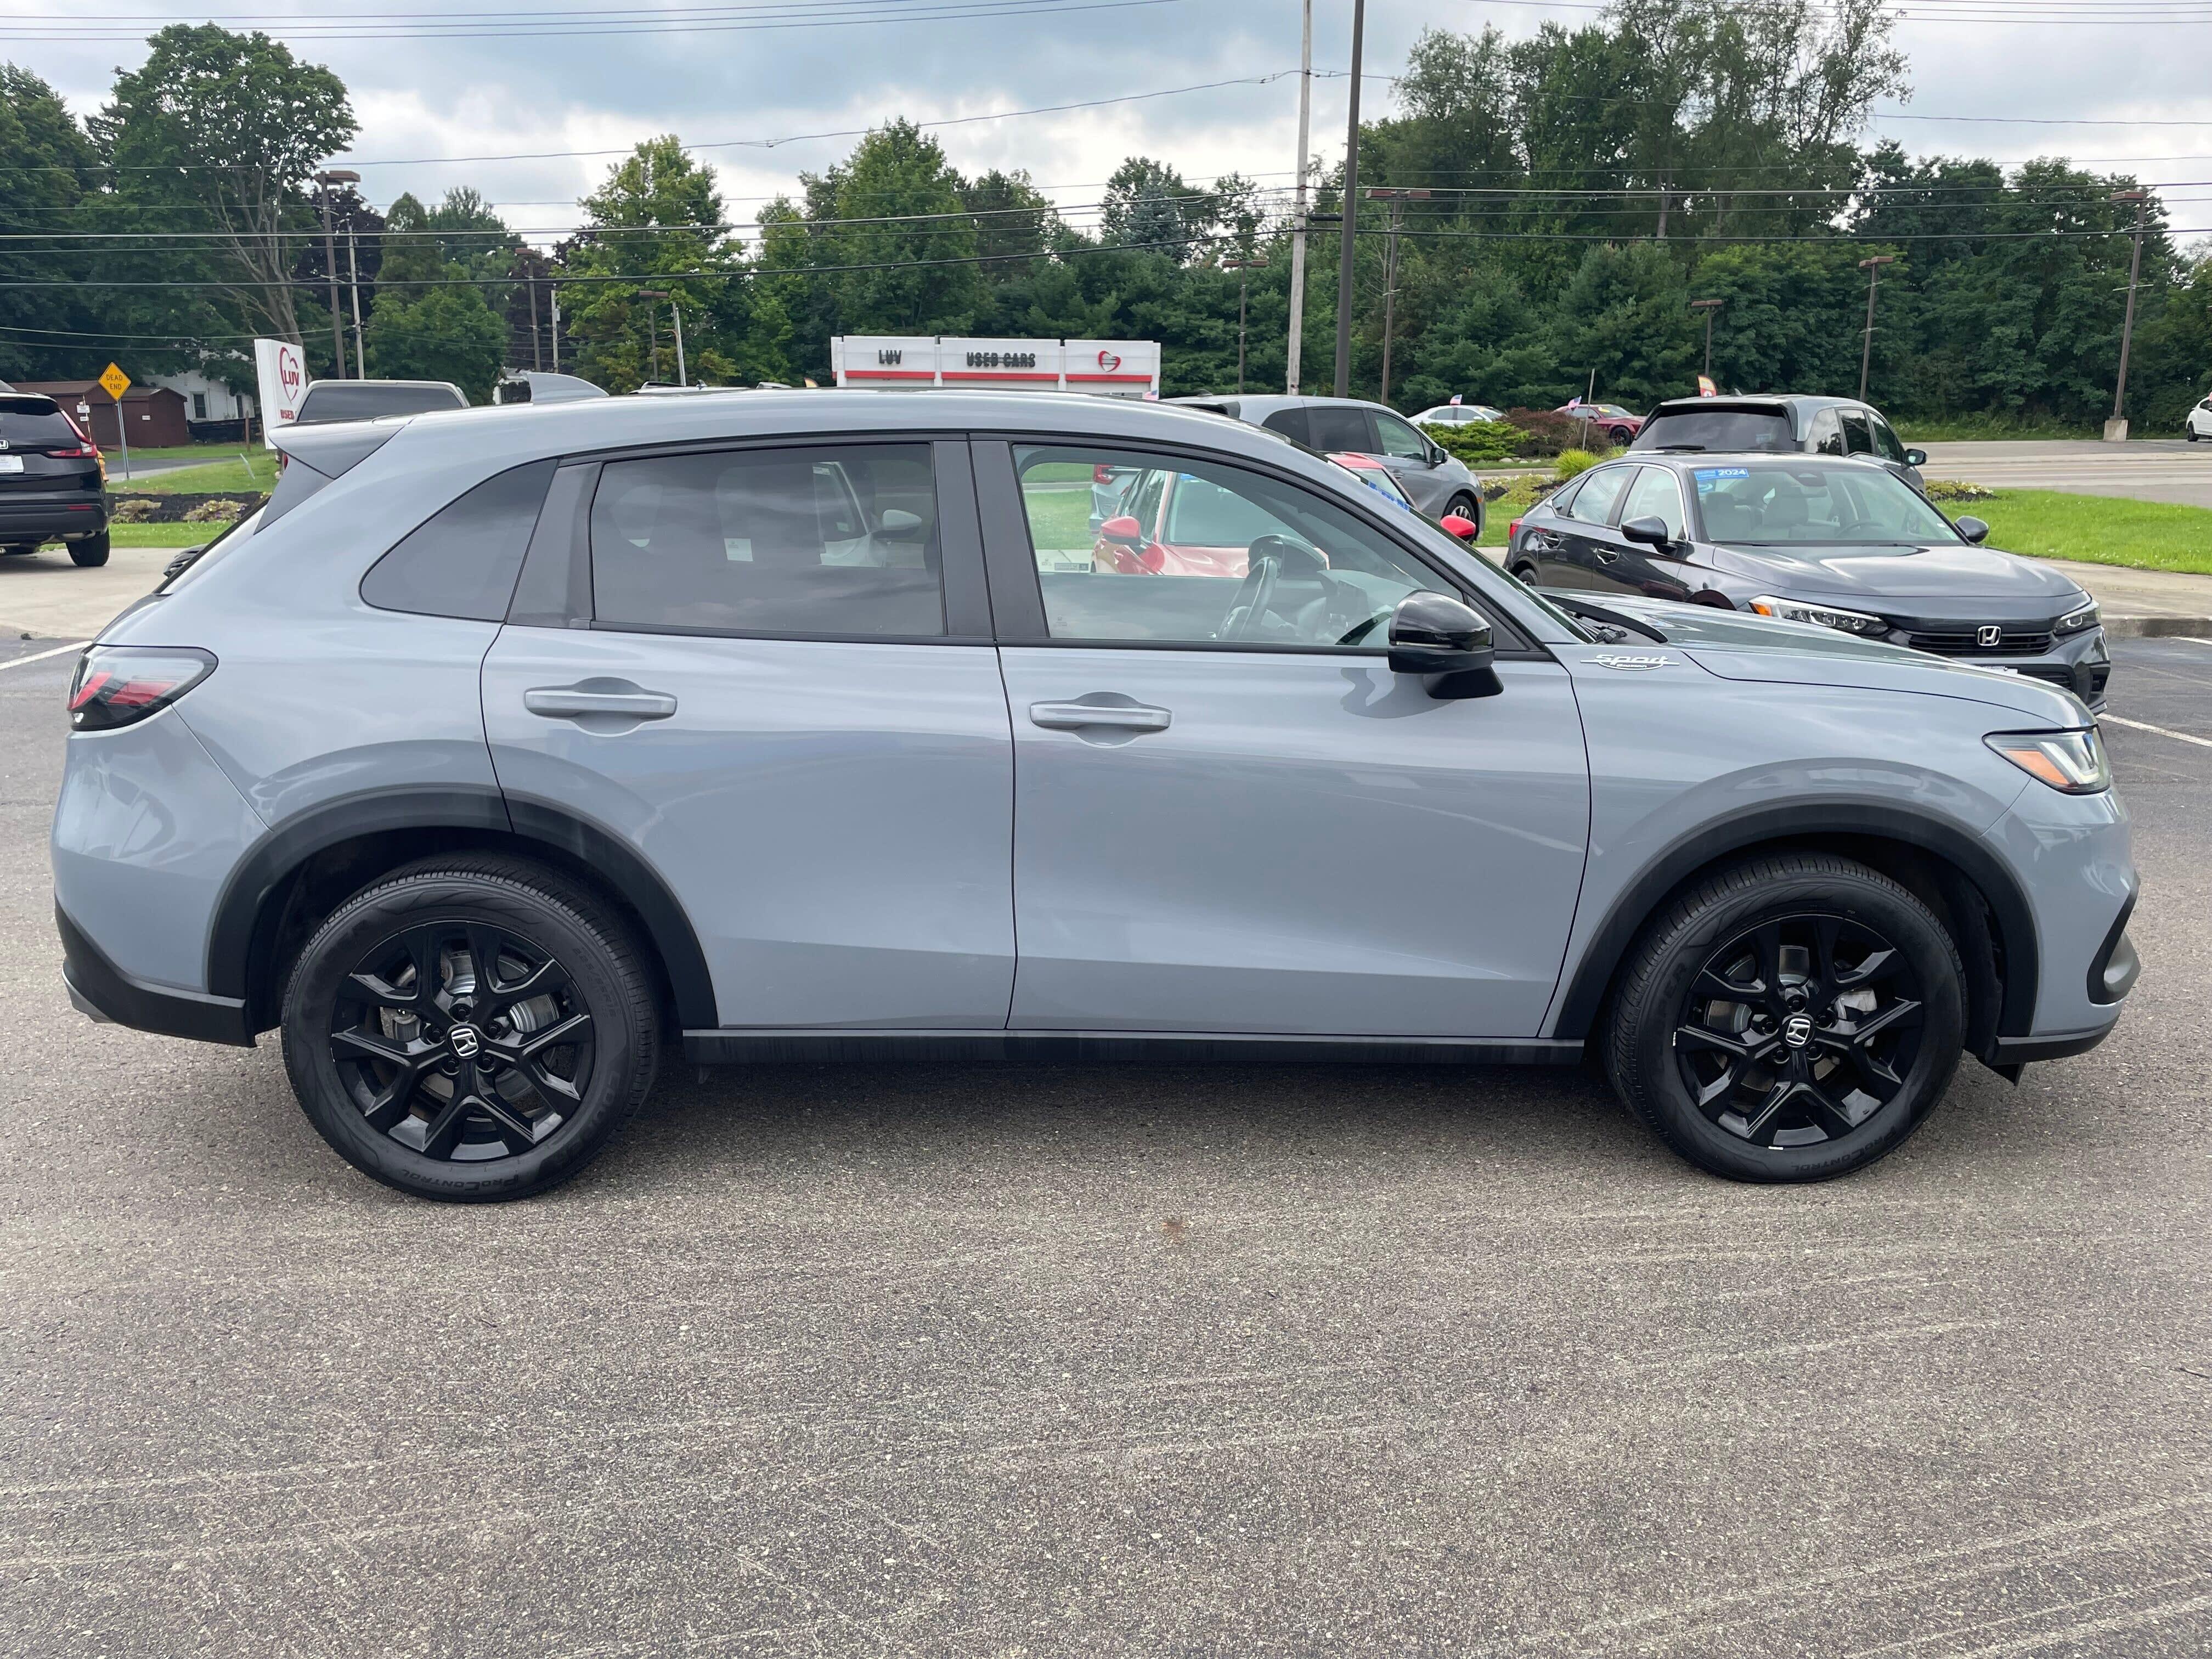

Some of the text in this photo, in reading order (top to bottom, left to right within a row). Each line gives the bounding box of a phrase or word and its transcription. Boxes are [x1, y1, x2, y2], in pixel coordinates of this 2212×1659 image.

[878, 349, 902, 364] LUV
[966, 352, 1036, 368] USED CARS
[283, 369, 299, 386] LUV
[280, 409, 295, 420] USED
[1595, 654, 1668, 665] Sport
